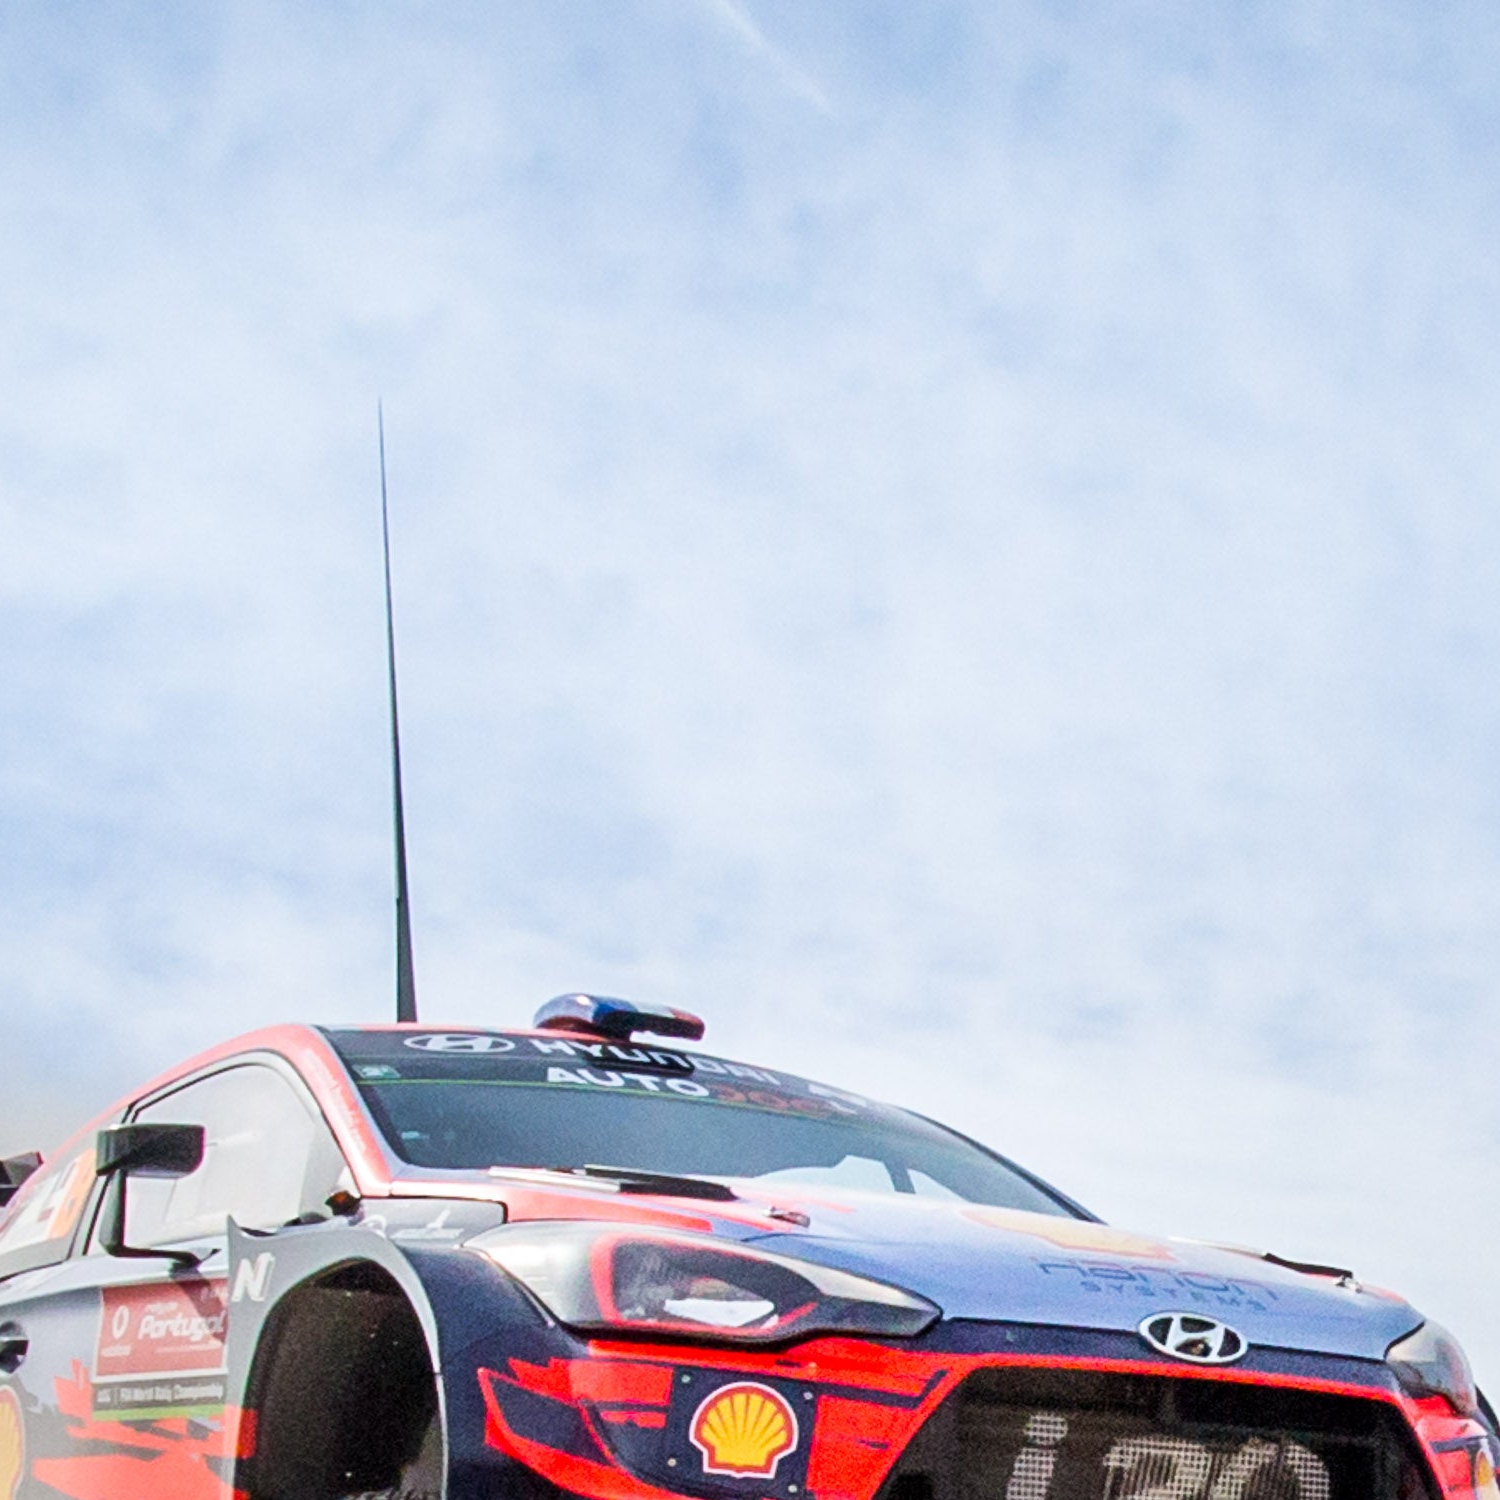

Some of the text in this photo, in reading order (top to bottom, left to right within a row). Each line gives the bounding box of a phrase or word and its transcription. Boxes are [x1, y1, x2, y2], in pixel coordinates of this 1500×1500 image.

[528, 1038, 781, 1086] HYUNDAI
[547, 1066, 710, 1097] AUTO
[138, 1309, 228, 1342] Portugal
